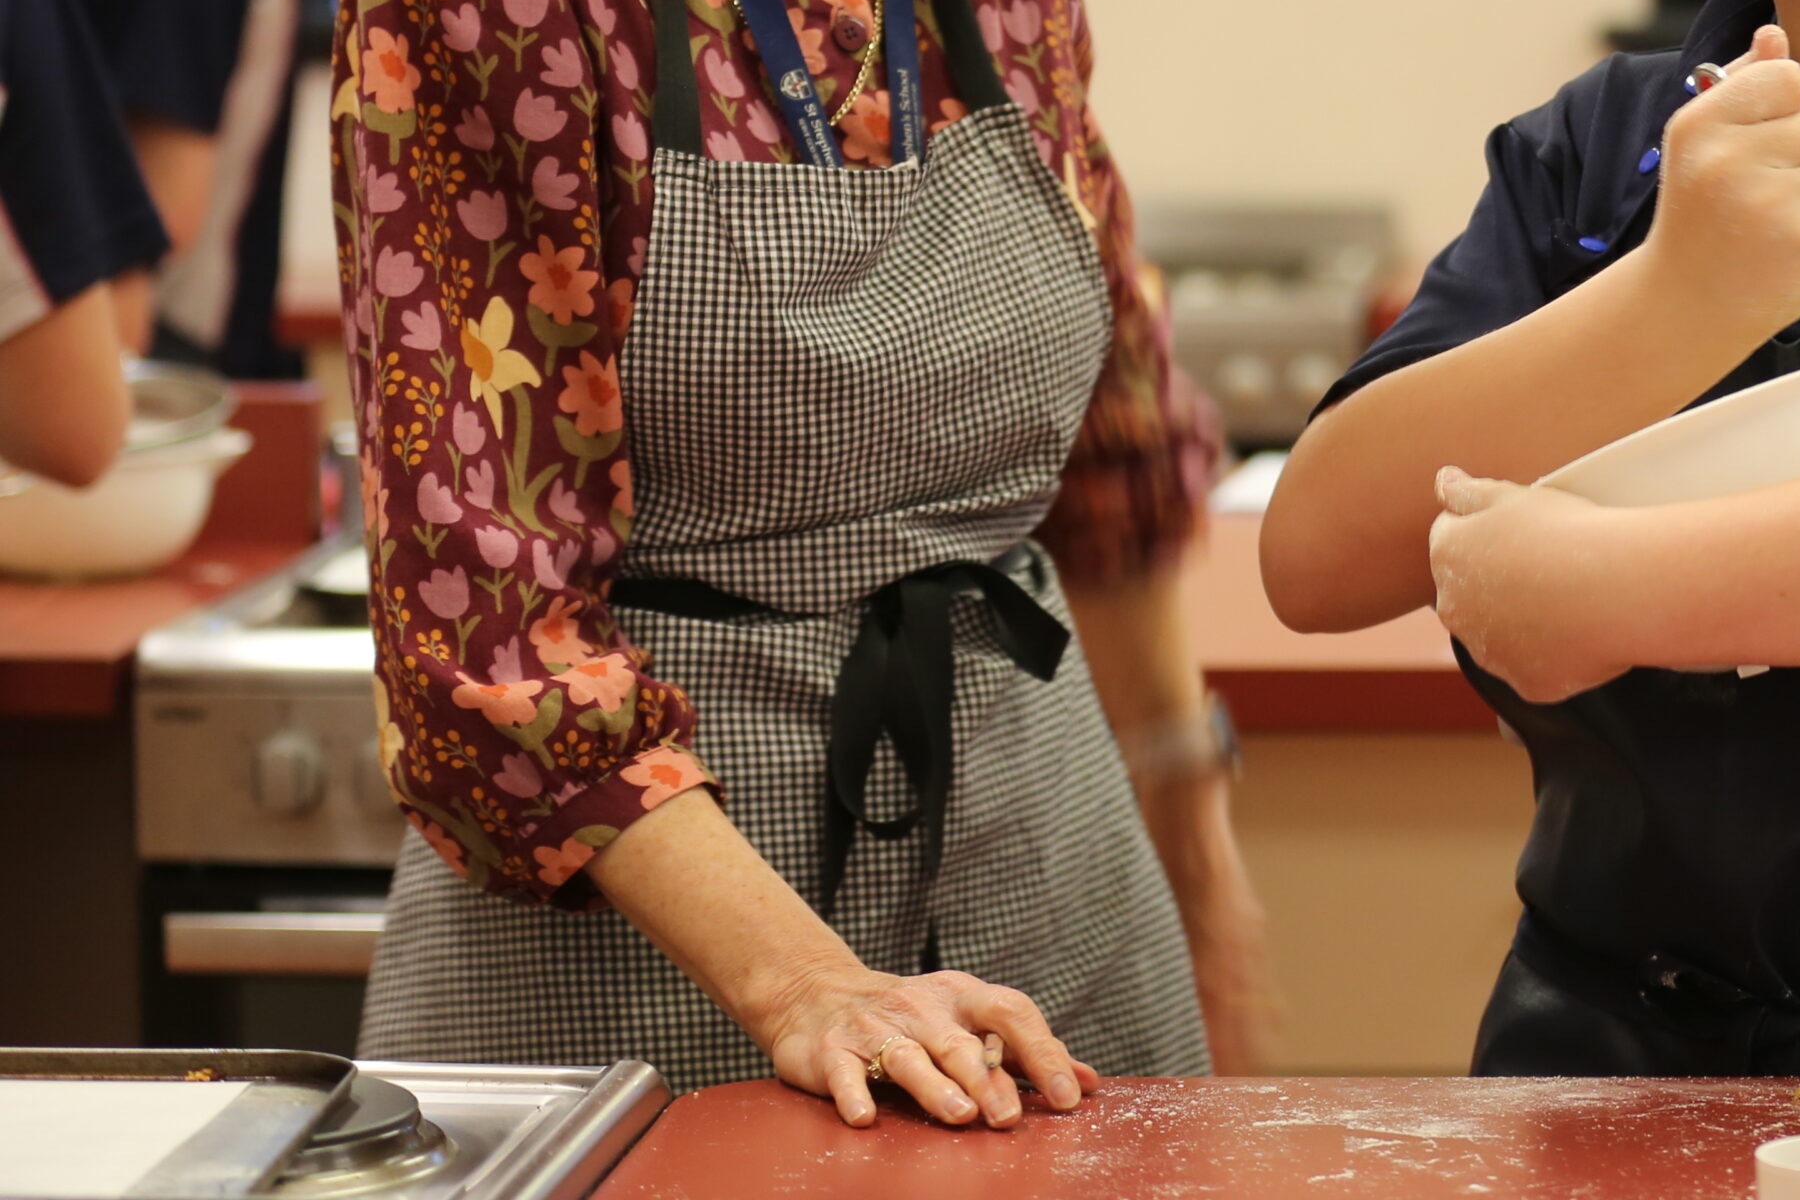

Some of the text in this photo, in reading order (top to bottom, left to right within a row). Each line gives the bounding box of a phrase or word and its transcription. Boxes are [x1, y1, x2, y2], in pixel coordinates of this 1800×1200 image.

[803, 103, 818, 118] St
[896, 68, 911, 112] School
[810, 118, 836, 168] Stephe
